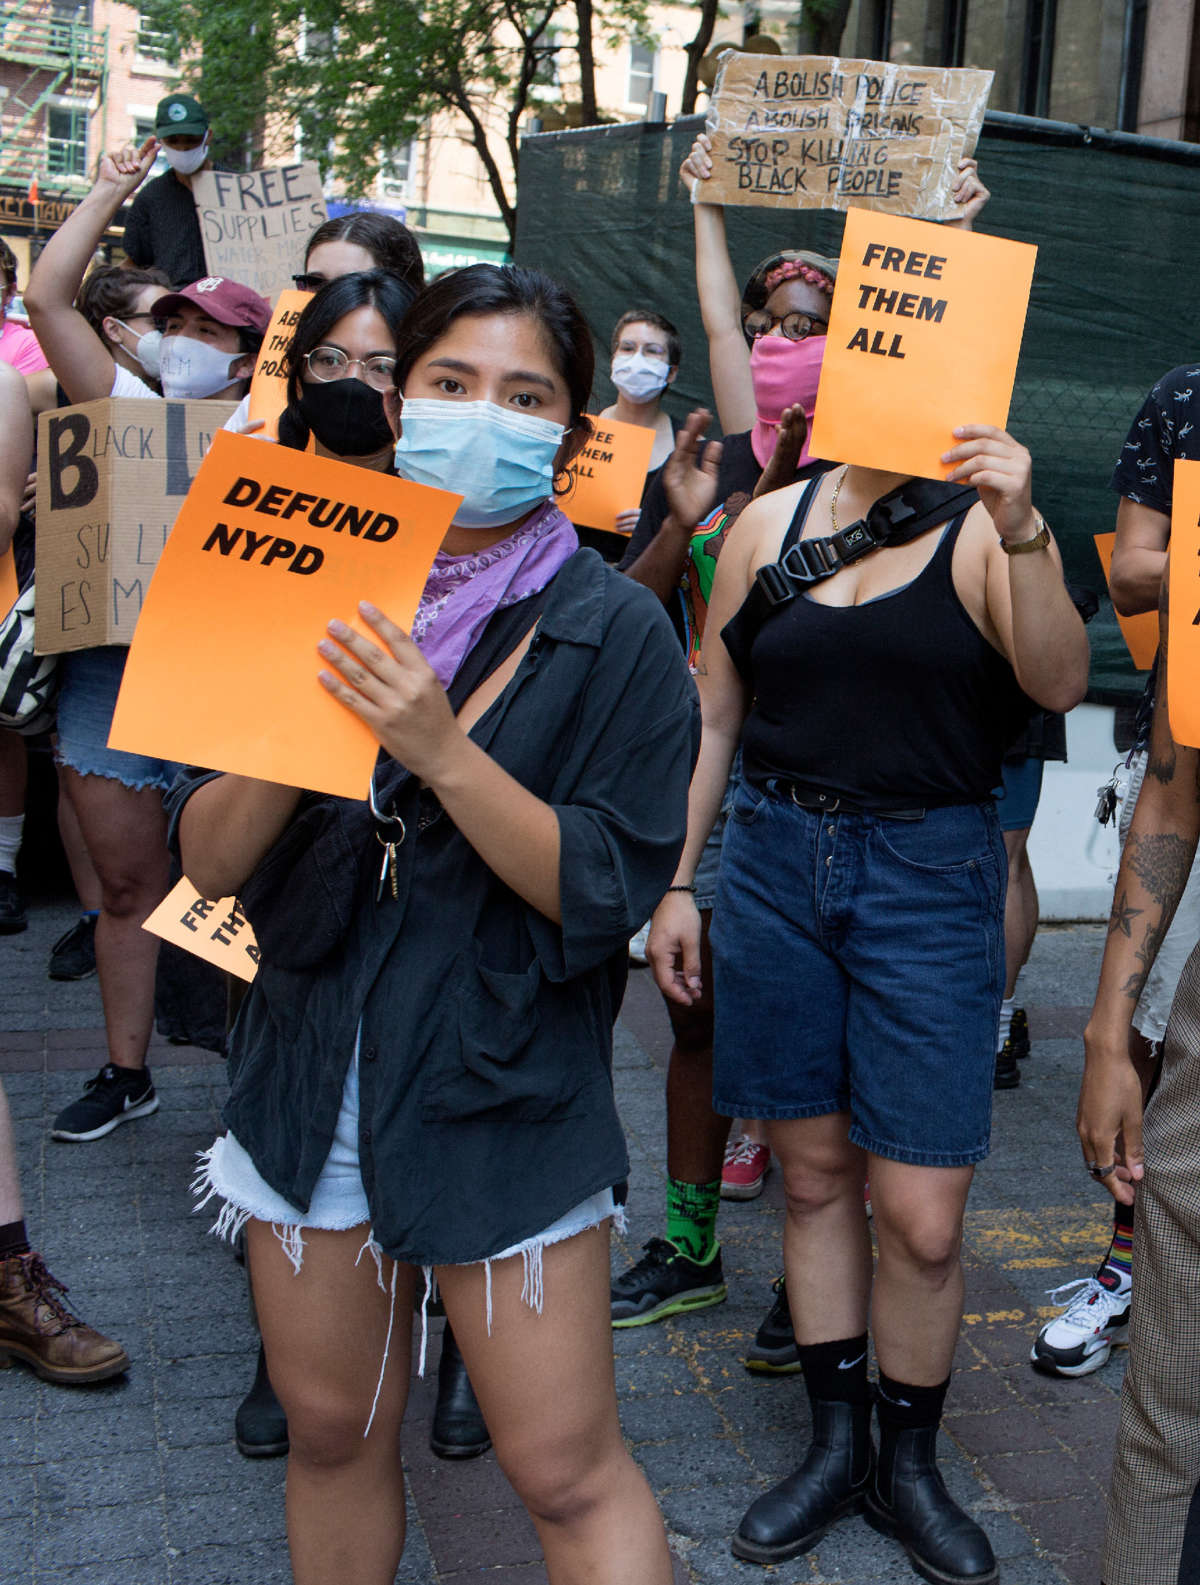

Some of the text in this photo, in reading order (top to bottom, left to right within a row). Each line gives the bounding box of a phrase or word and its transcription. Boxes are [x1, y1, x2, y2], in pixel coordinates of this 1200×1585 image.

[753, 70, 927, 103] ABOLISH POLICE
[744, 107, 924, 137] ABOLISH PRISONS
[725, 135, 888, 165] STOP KILLING
[214, 164, 312, 210] FREE
[738, 162, 902, 195] BLACK PEOPLE
[202, 203, 326, 243] SUPPLIES
[862, 243, 947, 280] FREE
[277, 310, 302, 326] AB
[858, 284, 948, 323] THEM
[846, 328, 906, 359] ALL
[595, 431, 614, 444] EE
[48, 413, 154, 511] BLACK
[571, 464, 594, 478] ALL
[580, 448, 614, 463] HEM
[222, 477, 399, 542] DEFUND
[77, 523, 110, 569] SU
[202, 523, 324, 575] NYPD
[61, 578, 142, 631] ES M
[180, 898, 215, 932] FR
[210, 905, 246, 946] TH
